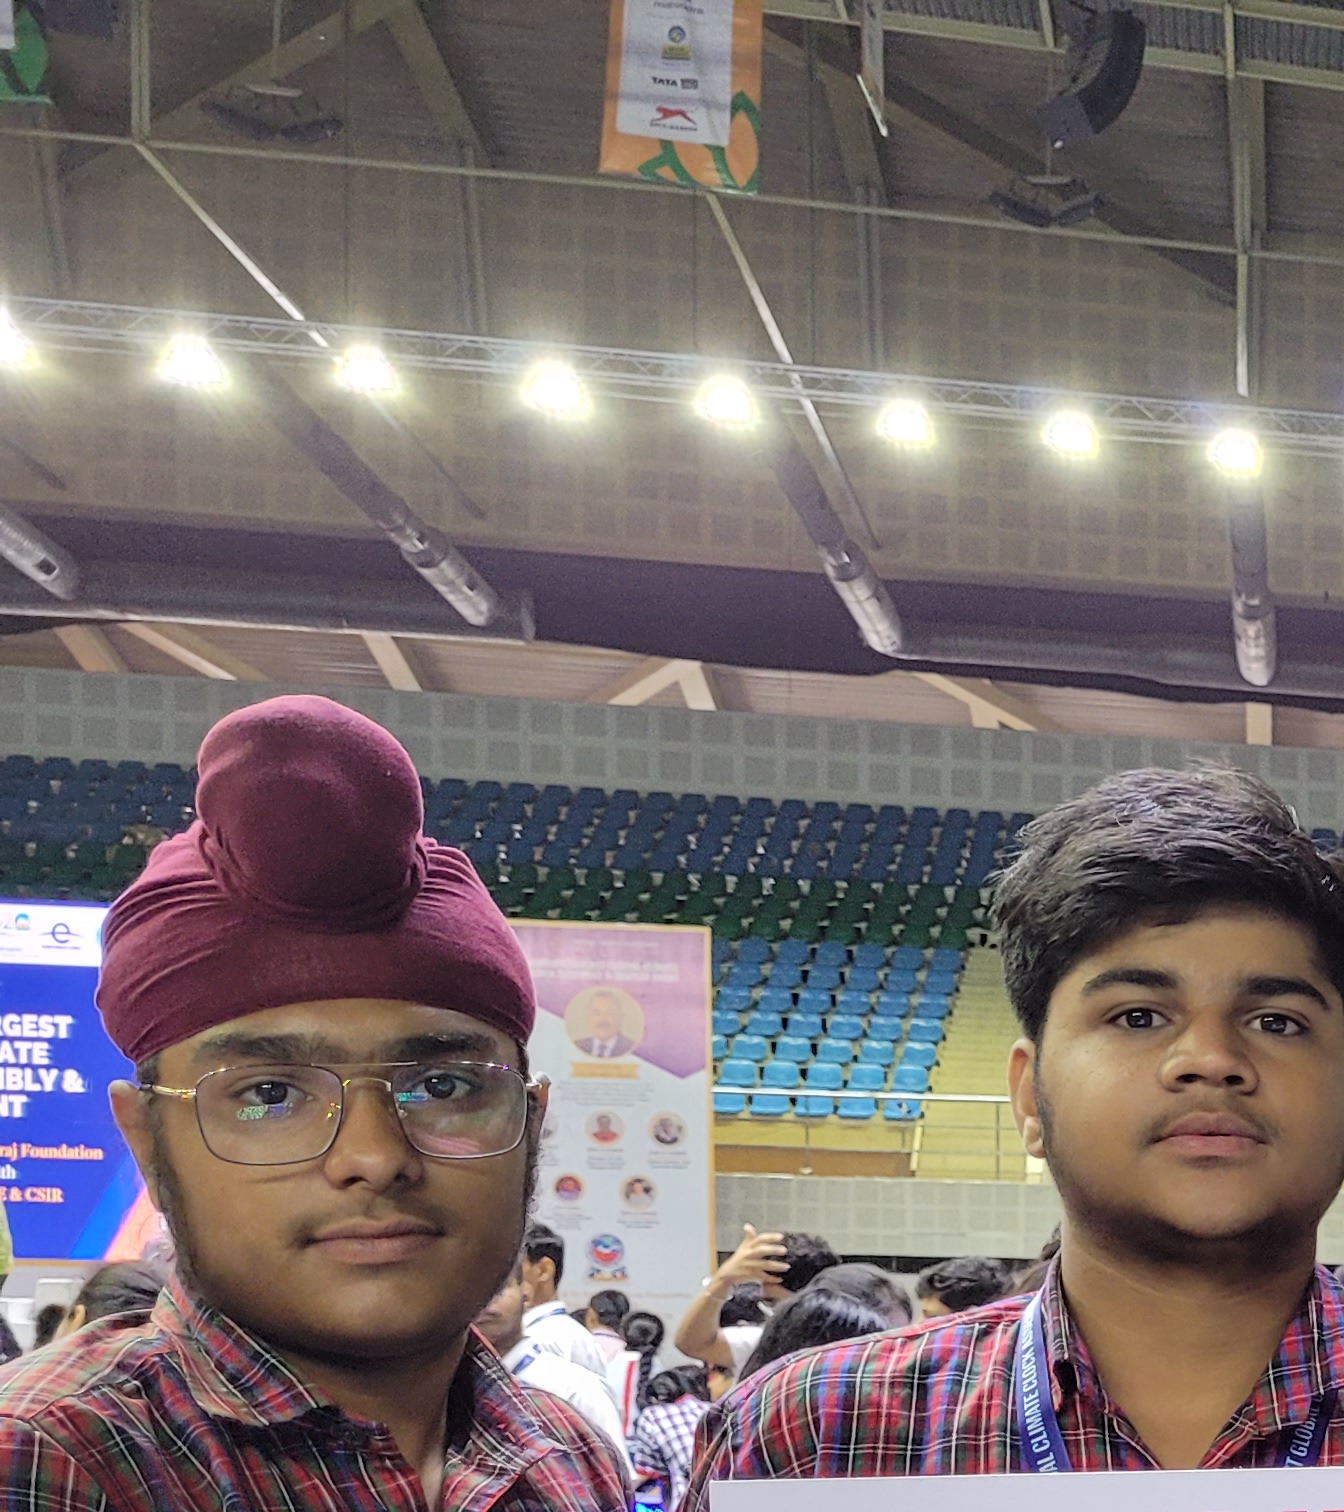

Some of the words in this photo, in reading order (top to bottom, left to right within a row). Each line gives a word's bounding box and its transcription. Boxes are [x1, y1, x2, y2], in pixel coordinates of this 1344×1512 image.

[62, 1068, 85, 1093] &
[20, 1144, 104, 1160] Foundation
[24, 1186, 64, 1203] CSIR
[1021, 1350, 1039, 1392] CLOCK
[1023, 1390, 1050, 1453] CLIMATE
